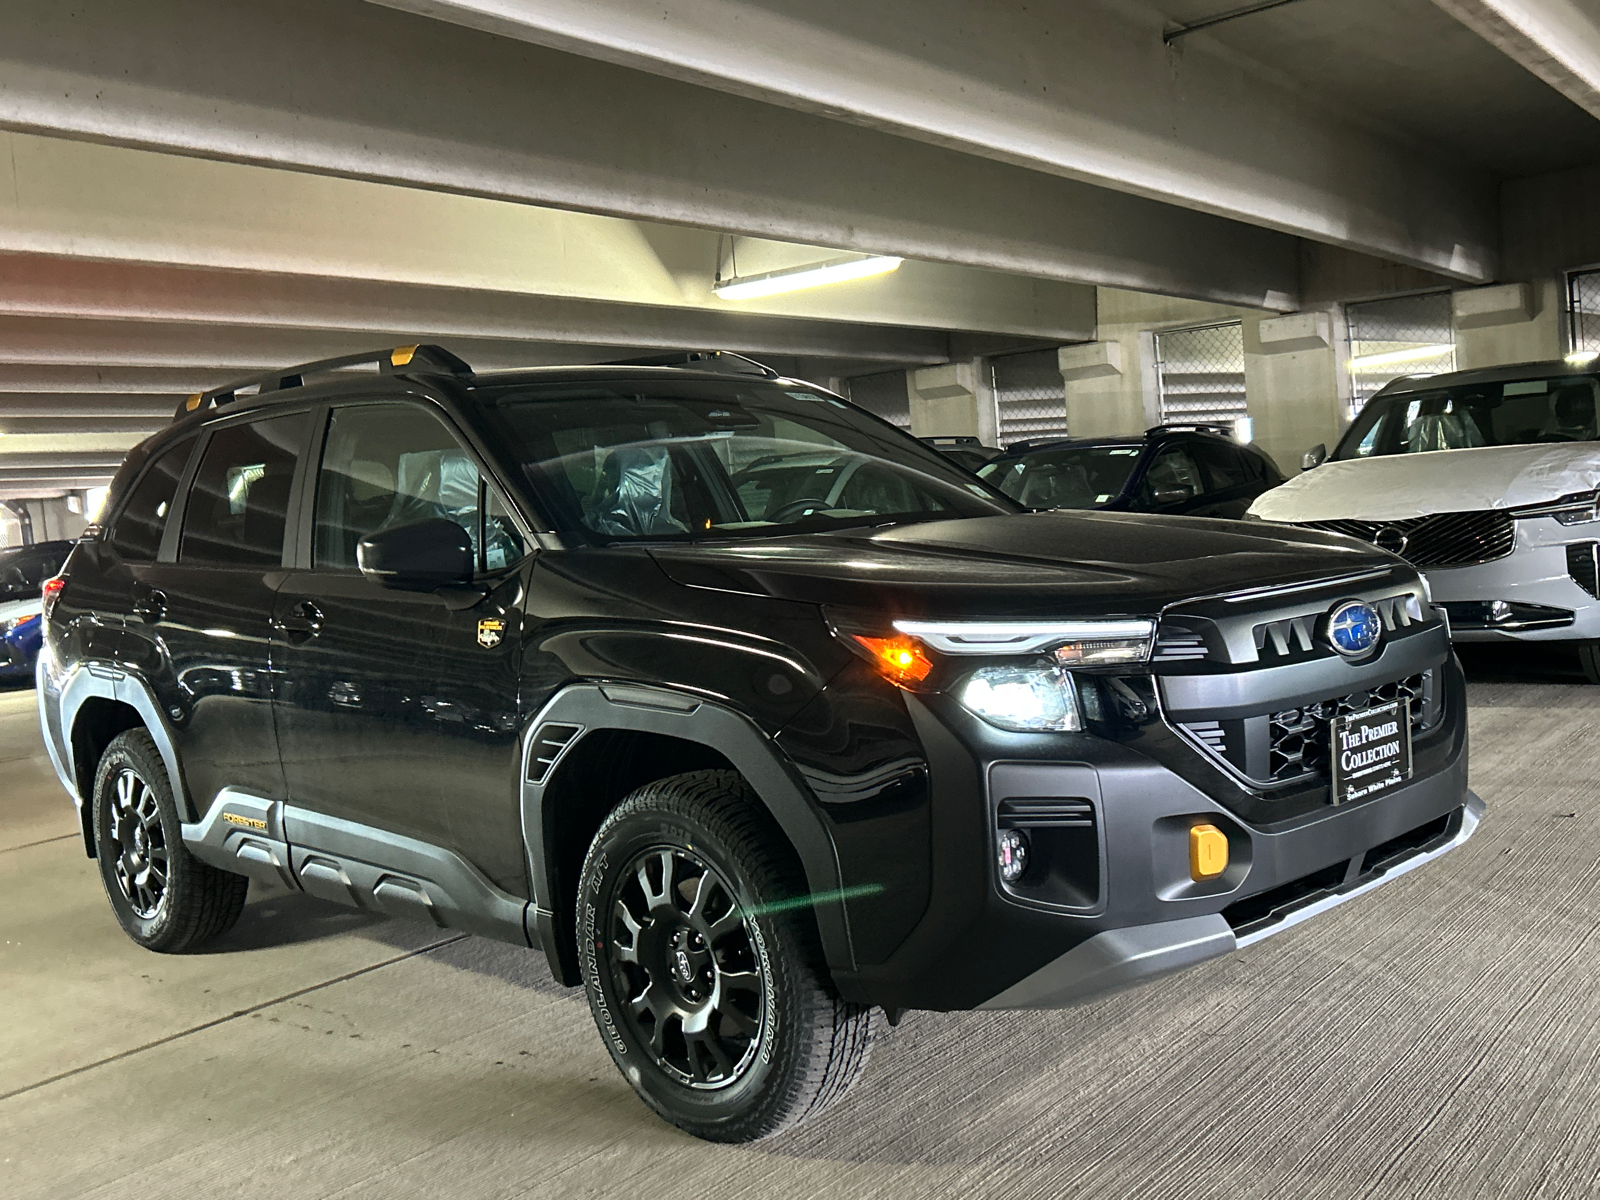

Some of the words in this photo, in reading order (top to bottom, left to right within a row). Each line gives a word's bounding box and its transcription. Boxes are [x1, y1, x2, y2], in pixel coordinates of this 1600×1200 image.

[1340, 731, 1361, 750] THE
[1360, 721, 1398, 744] PREMIER
[1341, 740, 1400, 771] COLLECTION
[223, 812, 267, 830] FORESTER
